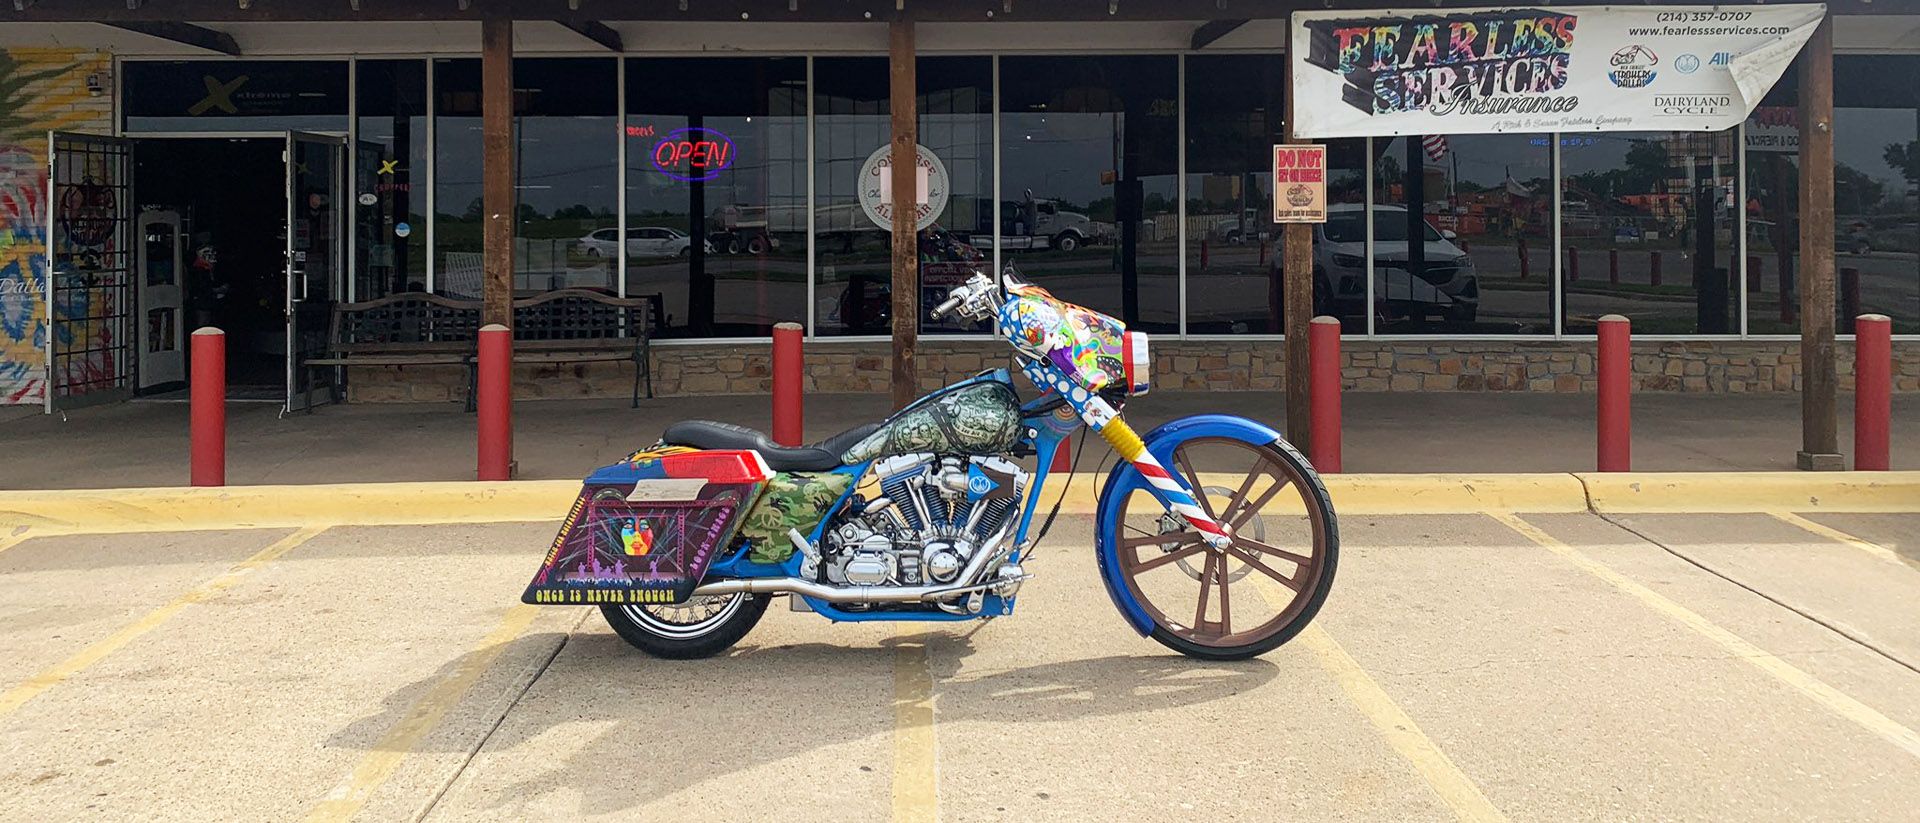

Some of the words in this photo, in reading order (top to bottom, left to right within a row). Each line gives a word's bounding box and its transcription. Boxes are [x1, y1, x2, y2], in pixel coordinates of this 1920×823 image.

[1657, 12, 1688, 23] (214)
[1691, 11, 1753, 22] 357-0707
[1628, 25, 1790, 36] www.fearlessservices.com
[1333, 16, 1577, 75] FEARLESS
[1372, 53, 1571, 114] SERVICES
[1430, 80, 1579, 116] Insurance
[1654, 96, 1730, 107] DAIRYLAND
[656, 141, 729, 167] OPEN
[1278, 149, 1296, 167] DO
[1297, 149, 1322, 167] NOT
[536, 590, 564, 602] ONCE
[570, 590, 581, 602] IS
[587, 590, 624, 602] NEVER
[630, 590, 674, 602] ENOUGH
